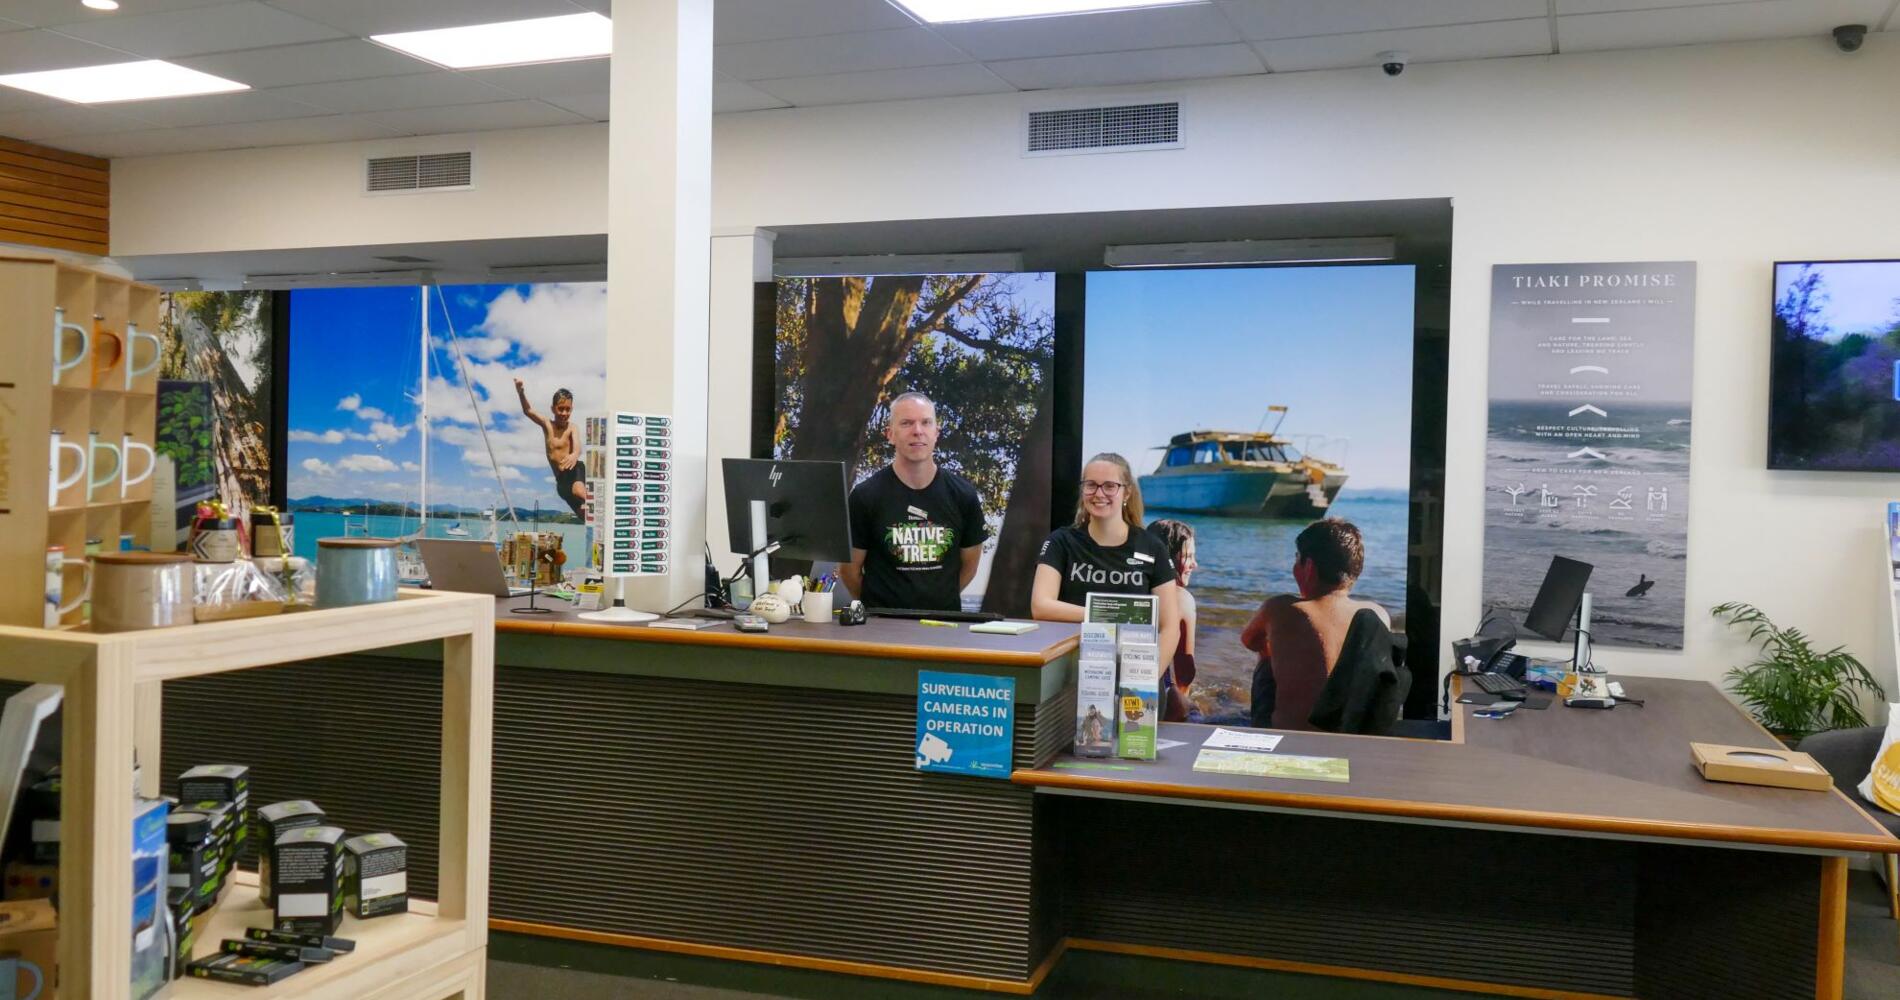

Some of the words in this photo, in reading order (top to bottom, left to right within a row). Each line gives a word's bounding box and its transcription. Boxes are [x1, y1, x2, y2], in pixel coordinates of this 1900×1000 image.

[1512, 274, 1569, 288] TIAKI
[1579, 273, 1675, 288] PROMISE
[768, 464, 782, 487] hp
[892, 526, 945, 545] NATIVE
[900, 544, 937, 562] TREE
[1070, 562, 1106, 584] Kia
[1109, 570, 1144, 586] ora
[922, 682, 1011, 700] SURVEILLANCE
[924, 700, 989, 718] CAMERAS
[992, 706, 1007, 719] IN
[926, 719, 1004, 737] OPERATION
